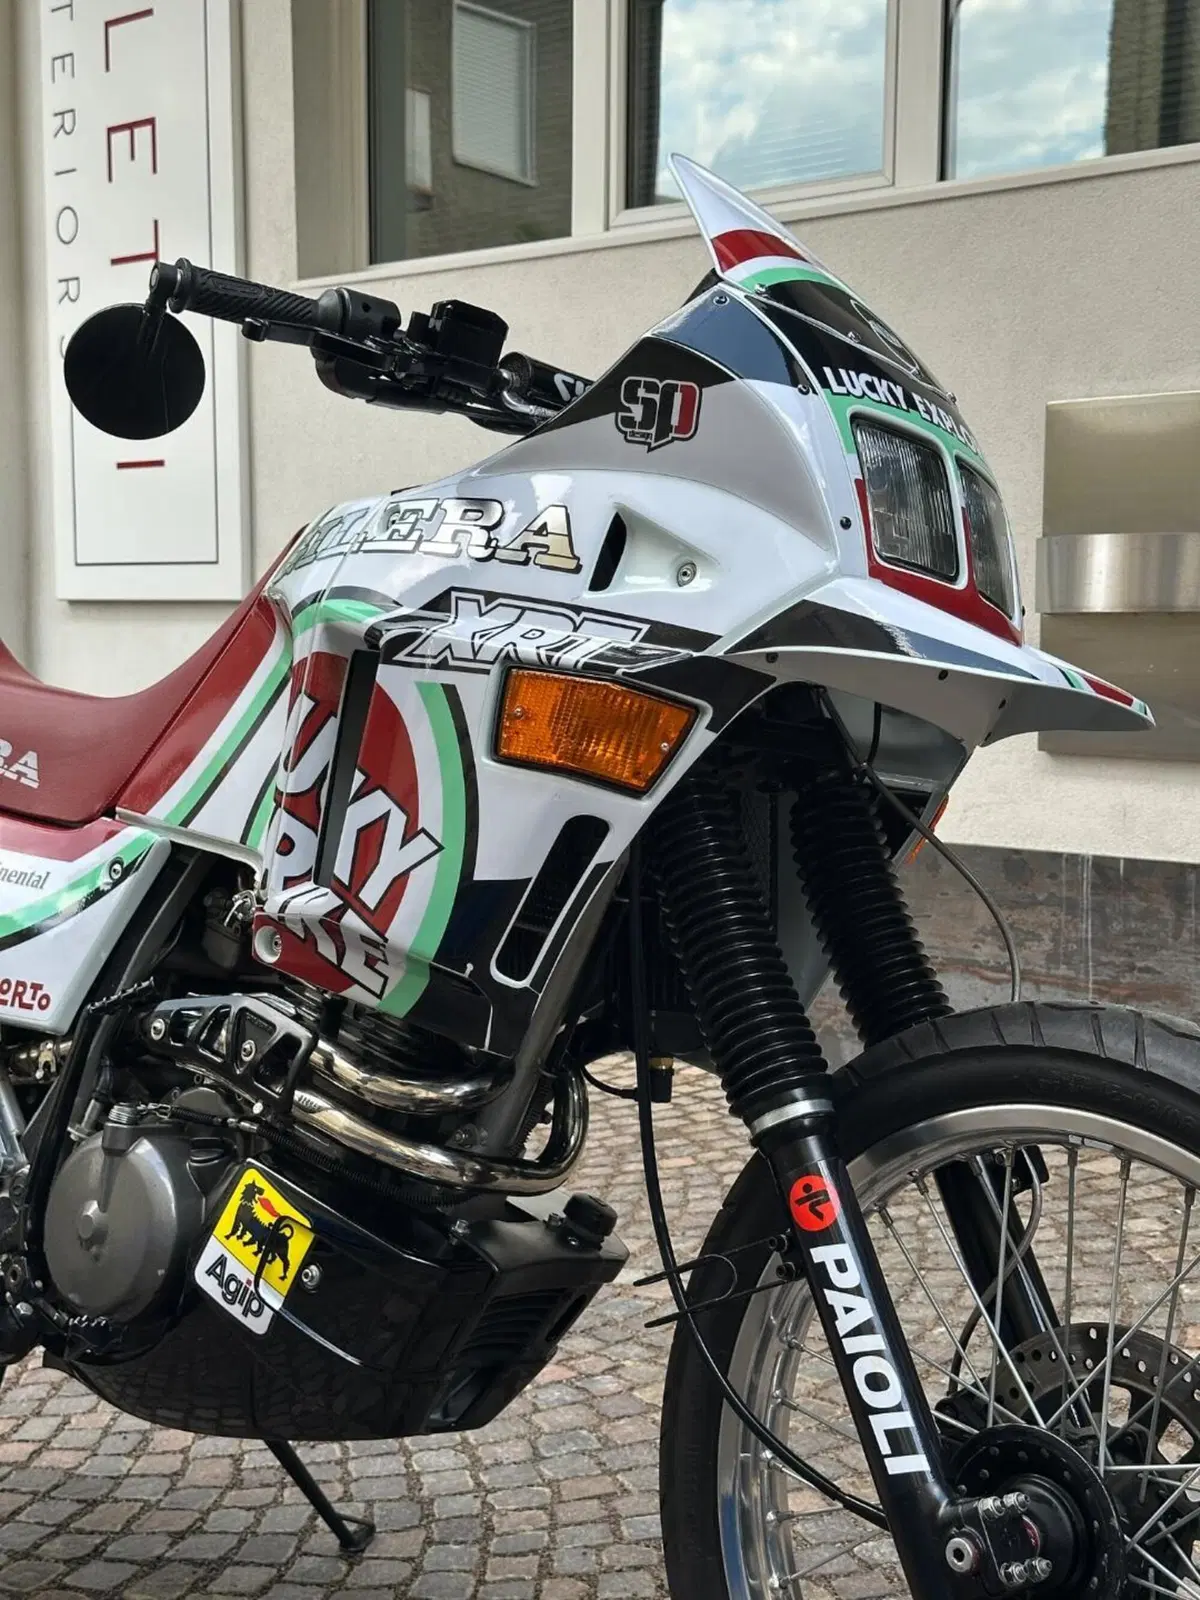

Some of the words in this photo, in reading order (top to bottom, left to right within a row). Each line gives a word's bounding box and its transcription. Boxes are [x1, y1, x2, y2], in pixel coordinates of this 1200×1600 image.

[104, 8, 165, 470] LETI
[822, 366, 910, 412] LUCKY
[911, 391, 979, 455] EXPLO
[392, 591, 651, 670] XRT
[0, 862, 52, 889] nental
[0, 978, 51, 1011] ORTO
[205, 1253, 265, 1318] Agip
[809, 1243, 931, 1476] PAIOLI
